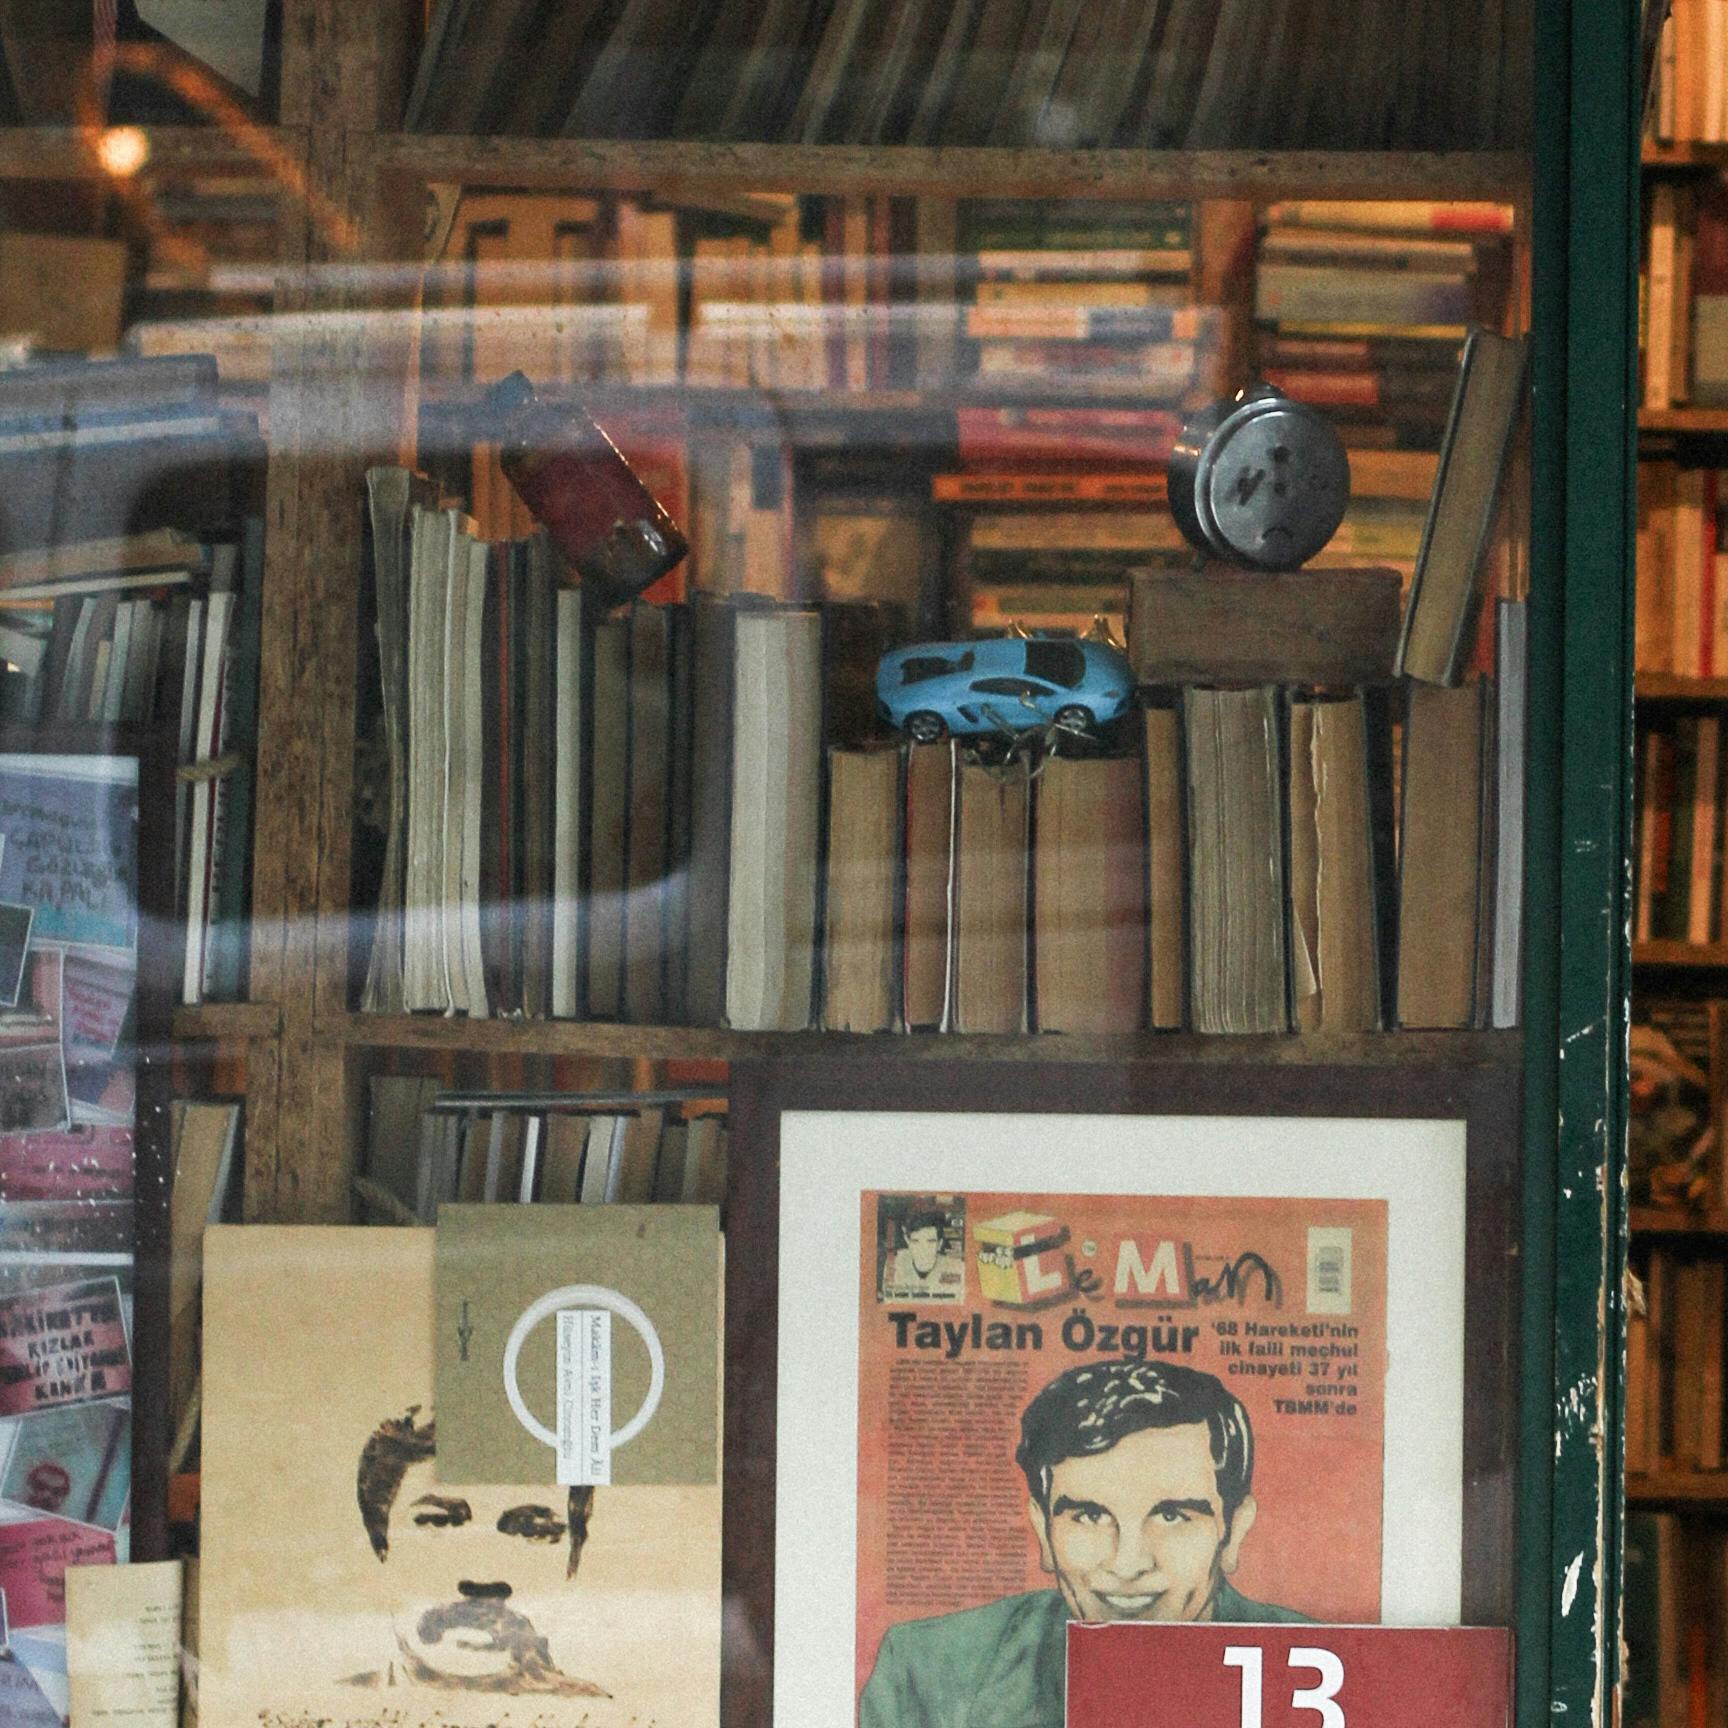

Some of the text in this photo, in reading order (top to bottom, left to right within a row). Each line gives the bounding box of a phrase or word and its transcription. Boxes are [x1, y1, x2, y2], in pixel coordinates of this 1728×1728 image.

[888, 1308, 1200, 1361] Taylan Özgür
[1245, 1322, 1359, 1337] Hareketi'nin
[1219, 1341, 1241, 1356] ilk
[1248, 1341, 1283, 1356] faili
[1228, 1360, 1302, 1378] cinayeti
[1308, 1361, 1329, 1375] 37
[1306, 1383, 1358, 1396] sonra
[1273, 1399, 1358, 1414] TBMM'de
